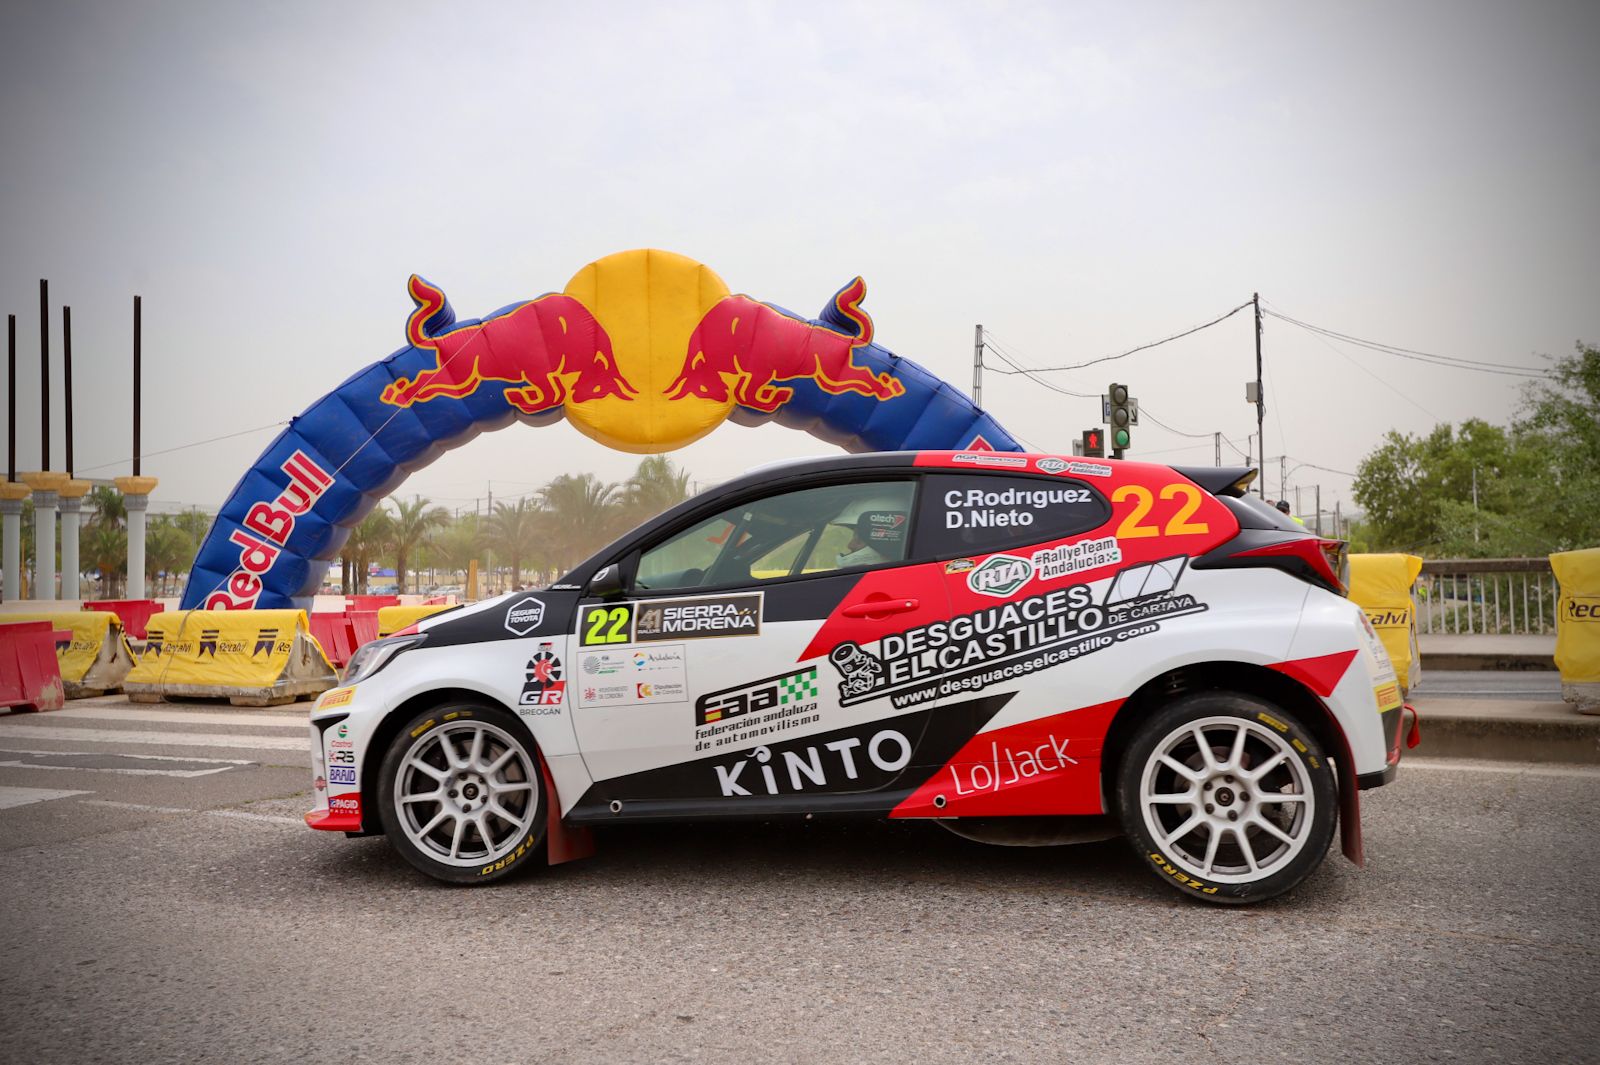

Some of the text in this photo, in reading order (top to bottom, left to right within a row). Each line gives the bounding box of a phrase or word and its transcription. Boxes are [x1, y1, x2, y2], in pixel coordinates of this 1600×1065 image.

[945, 510, 1034, 529] D.Nieto
[1111, 483, 1210, 539] 22
[205, 449, 336, 610] Red Bull
[1035, 539, 1114, 566] #RallyeTeam
[1042, 551, 1105, 577] Andalucía
[978, 561, 1026, 591] RTA
[510, 615, 539, 624] TOYOTA
[511, 608, 541, 617] SEGURO
[638, 603, 739, 629] 41 SIERRA
[662, 615, 756, 633] MORENA
[883, 585, 1090, 661] DESGUACES
[1108, 597, 1194, 625] DE CARTAYA
[585, 607, 630, 645] 22
[890, 607, 1103, 685] EL CASTILLO
[520, 690, 562, 705] GR
[695, 702, 818, 740] federación andaluza
[695, 713, 820, 752] de automovilismo
[329, 769, 356, 783] BRAID
[336, 799, 359, 810] PAGID
